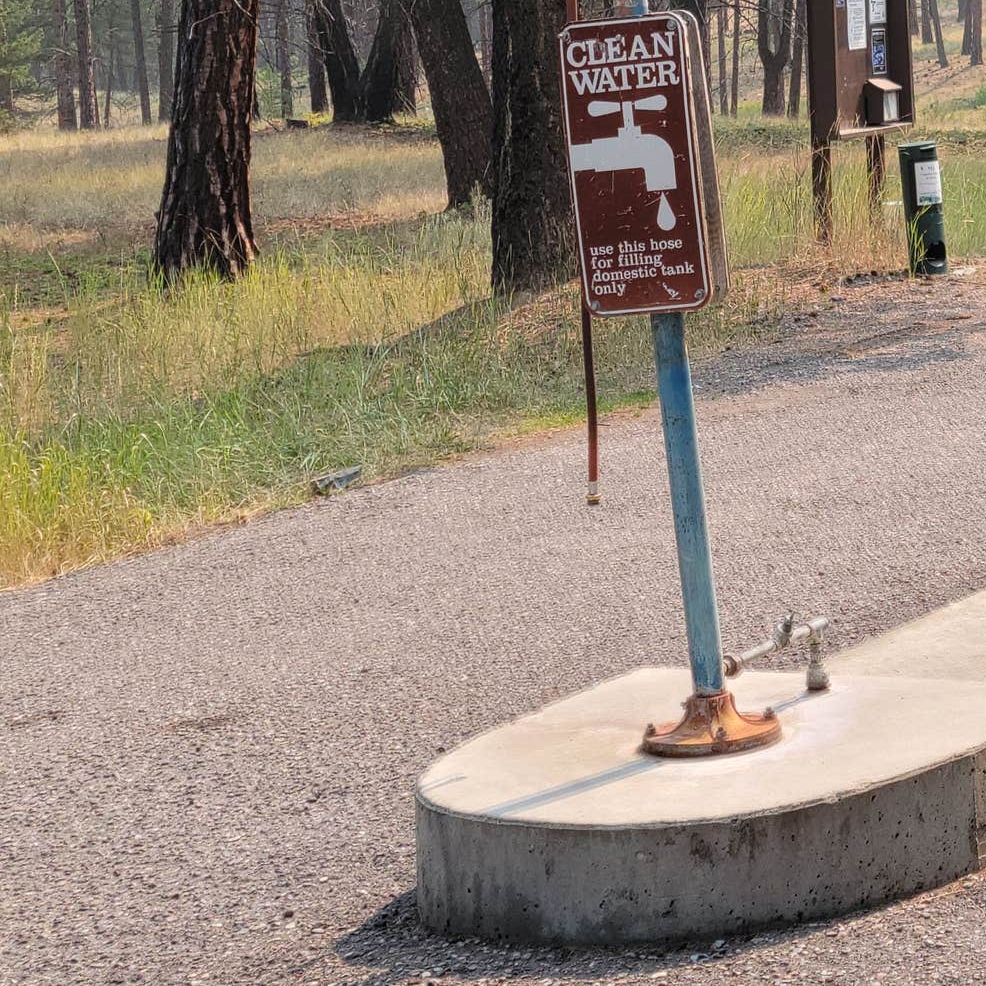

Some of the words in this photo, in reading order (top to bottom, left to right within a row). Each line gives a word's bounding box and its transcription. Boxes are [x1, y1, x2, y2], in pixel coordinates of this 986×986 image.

[566, 31, 675, 68] CLEAN
[567, 60, 680, 96] WATER
[590, 244, 614, 256] use
[618, 240, 646, 254] this
[650, 238, 683, 251] hose
[591, 256, 613, 270] for
[618, 253, 663, 268] filling
[592, 265, 657, 282] domestic
[661, 261, 695, 276] tank
[594, 281, 626, 297] only
